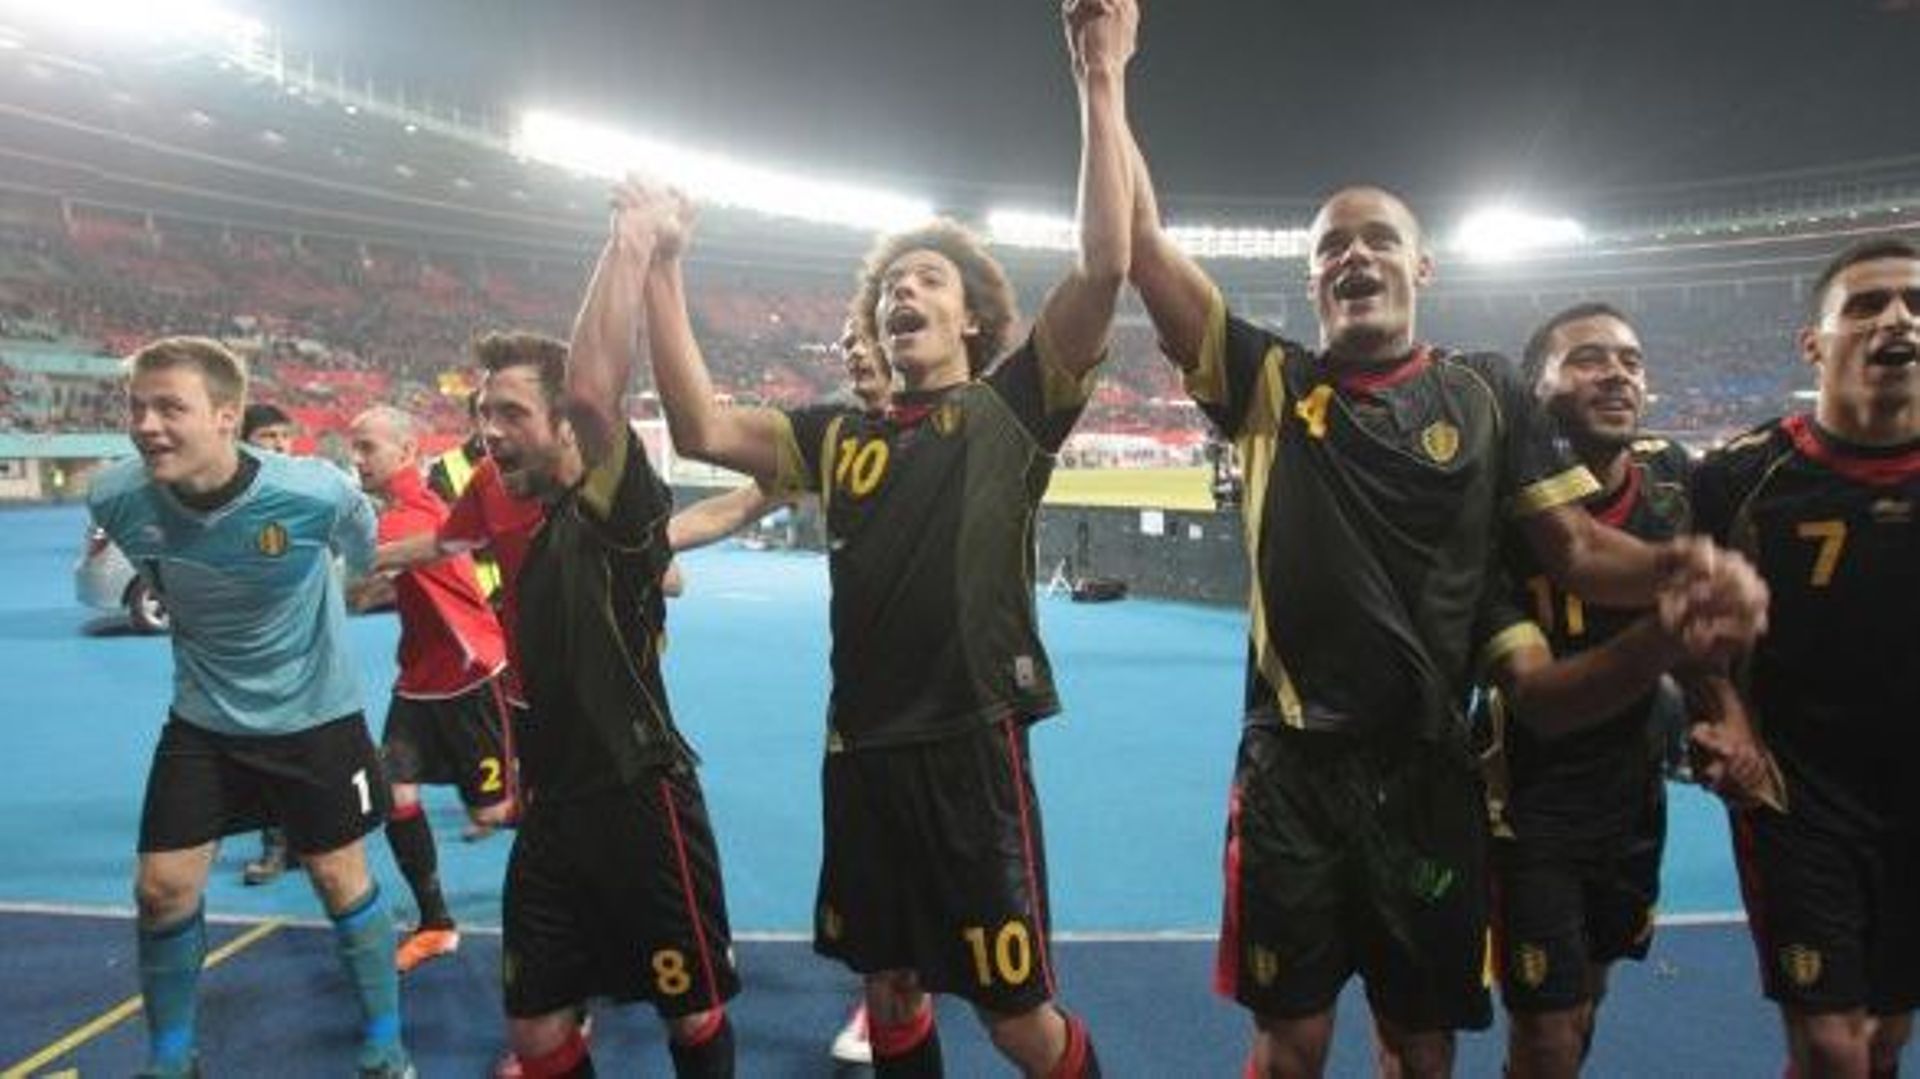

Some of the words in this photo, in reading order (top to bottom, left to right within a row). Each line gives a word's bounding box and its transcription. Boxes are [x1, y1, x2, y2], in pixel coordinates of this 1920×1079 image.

[836, 437, 889, 495] 10
[1797, 520, 1847, 587] 7
[351, 767, 372, 815] 1
[479, 757, 502, 792] 2
[652, 949, 691, 995] 8
[964, 920, 1030, 986] 10
